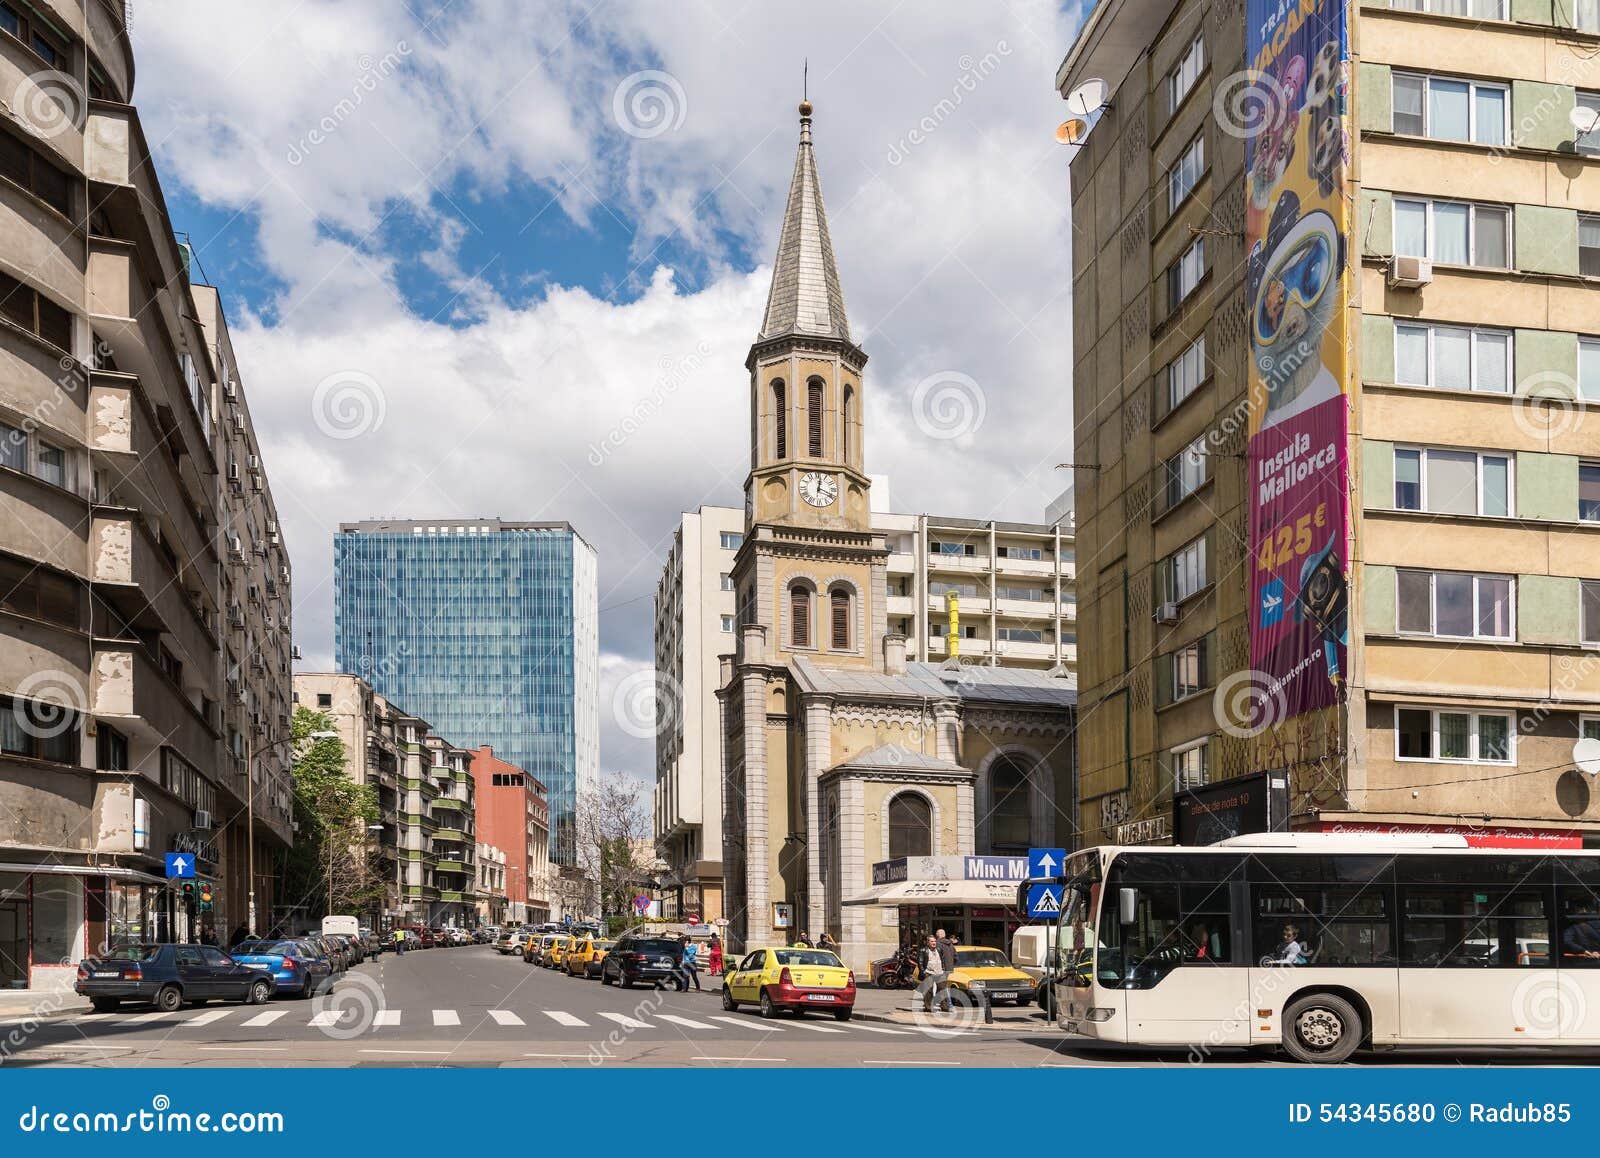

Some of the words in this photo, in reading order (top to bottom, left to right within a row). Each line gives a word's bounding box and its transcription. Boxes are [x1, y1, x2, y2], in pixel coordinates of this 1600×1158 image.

[1259, 432, 1310, 481] Insula
[1260, 443, 1336, 507] Mallorca
[1258, 648, 1321, 706] christiantour.ro
[968, 858, 1004, 879] MINI
